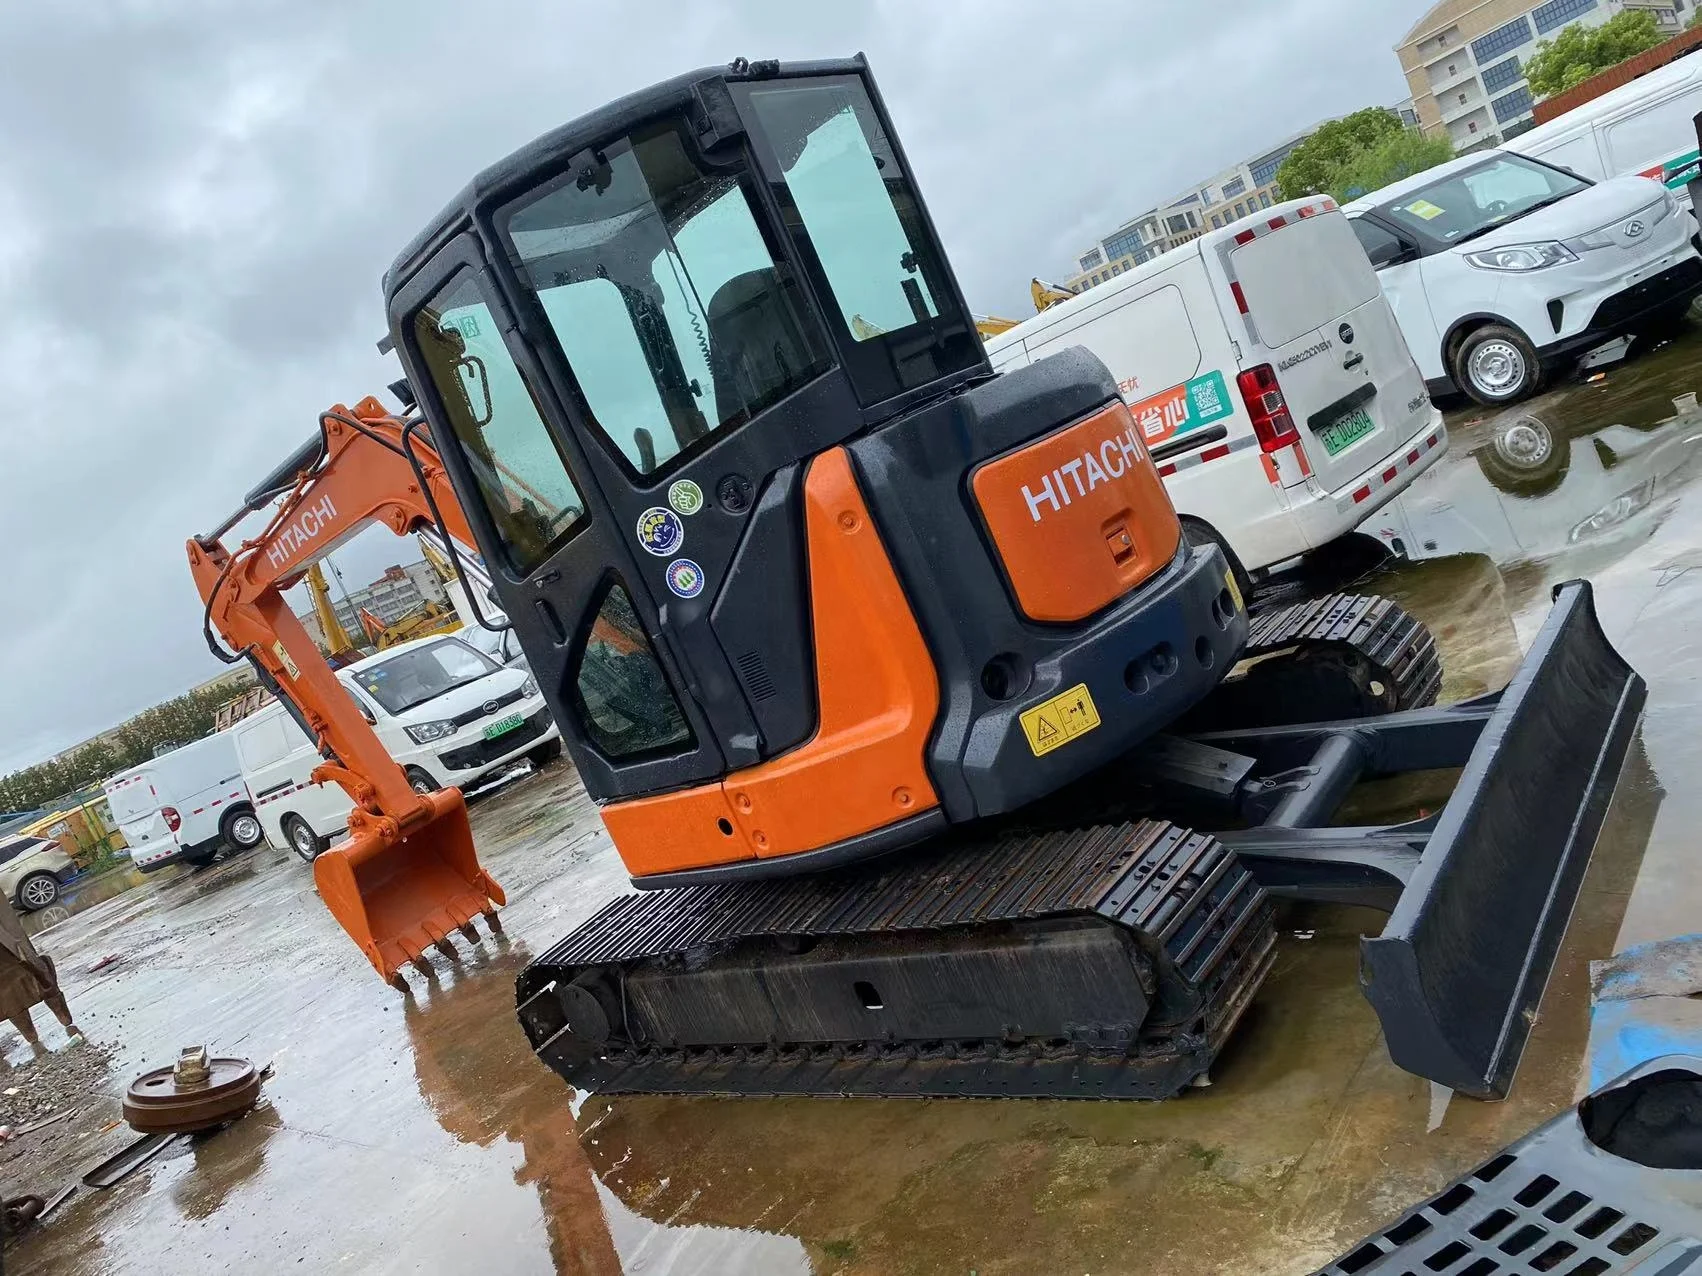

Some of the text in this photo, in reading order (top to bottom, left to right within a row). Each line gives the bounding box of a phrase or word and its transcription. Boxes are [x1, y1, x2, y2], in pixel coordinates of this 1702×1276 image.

[1133, 397, 1190, 438] 省心
[1021, 429, 1144, 522] HITACHI
[266, 494, 337, 569] HITACHI
